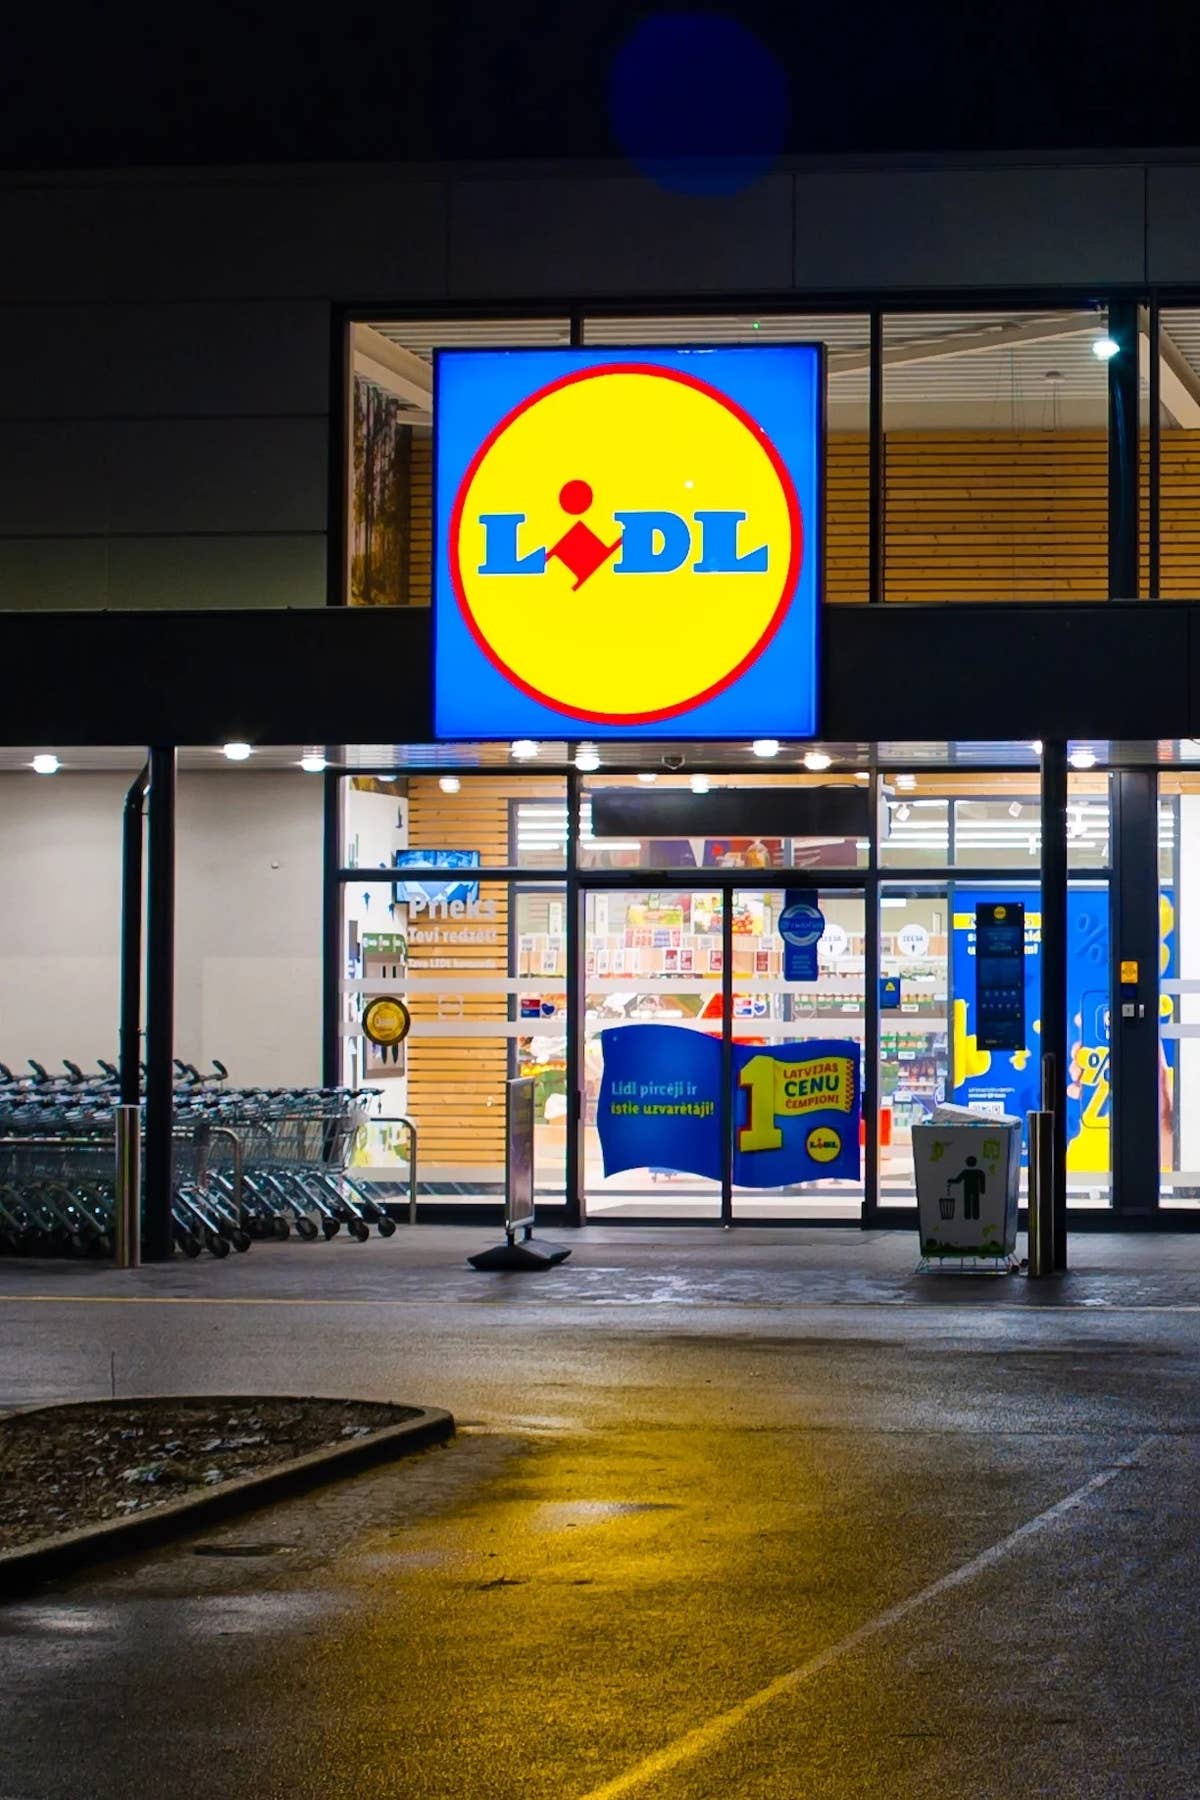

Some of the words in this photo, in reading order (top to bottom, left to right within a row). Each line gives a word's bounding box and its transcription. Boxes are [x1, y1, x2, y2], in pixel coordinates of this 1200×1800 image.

[409, 892, 497, 920] Prieks
[783, 1063, 839, 1079] LATVIJAS
[611, 1081, 637, 1095] Lidl
[686, 1081, 697, 1095] ir
[784, 1075, 840, 1097] CENU
[785, 1095, 839, 1109] ČEMPIONI
